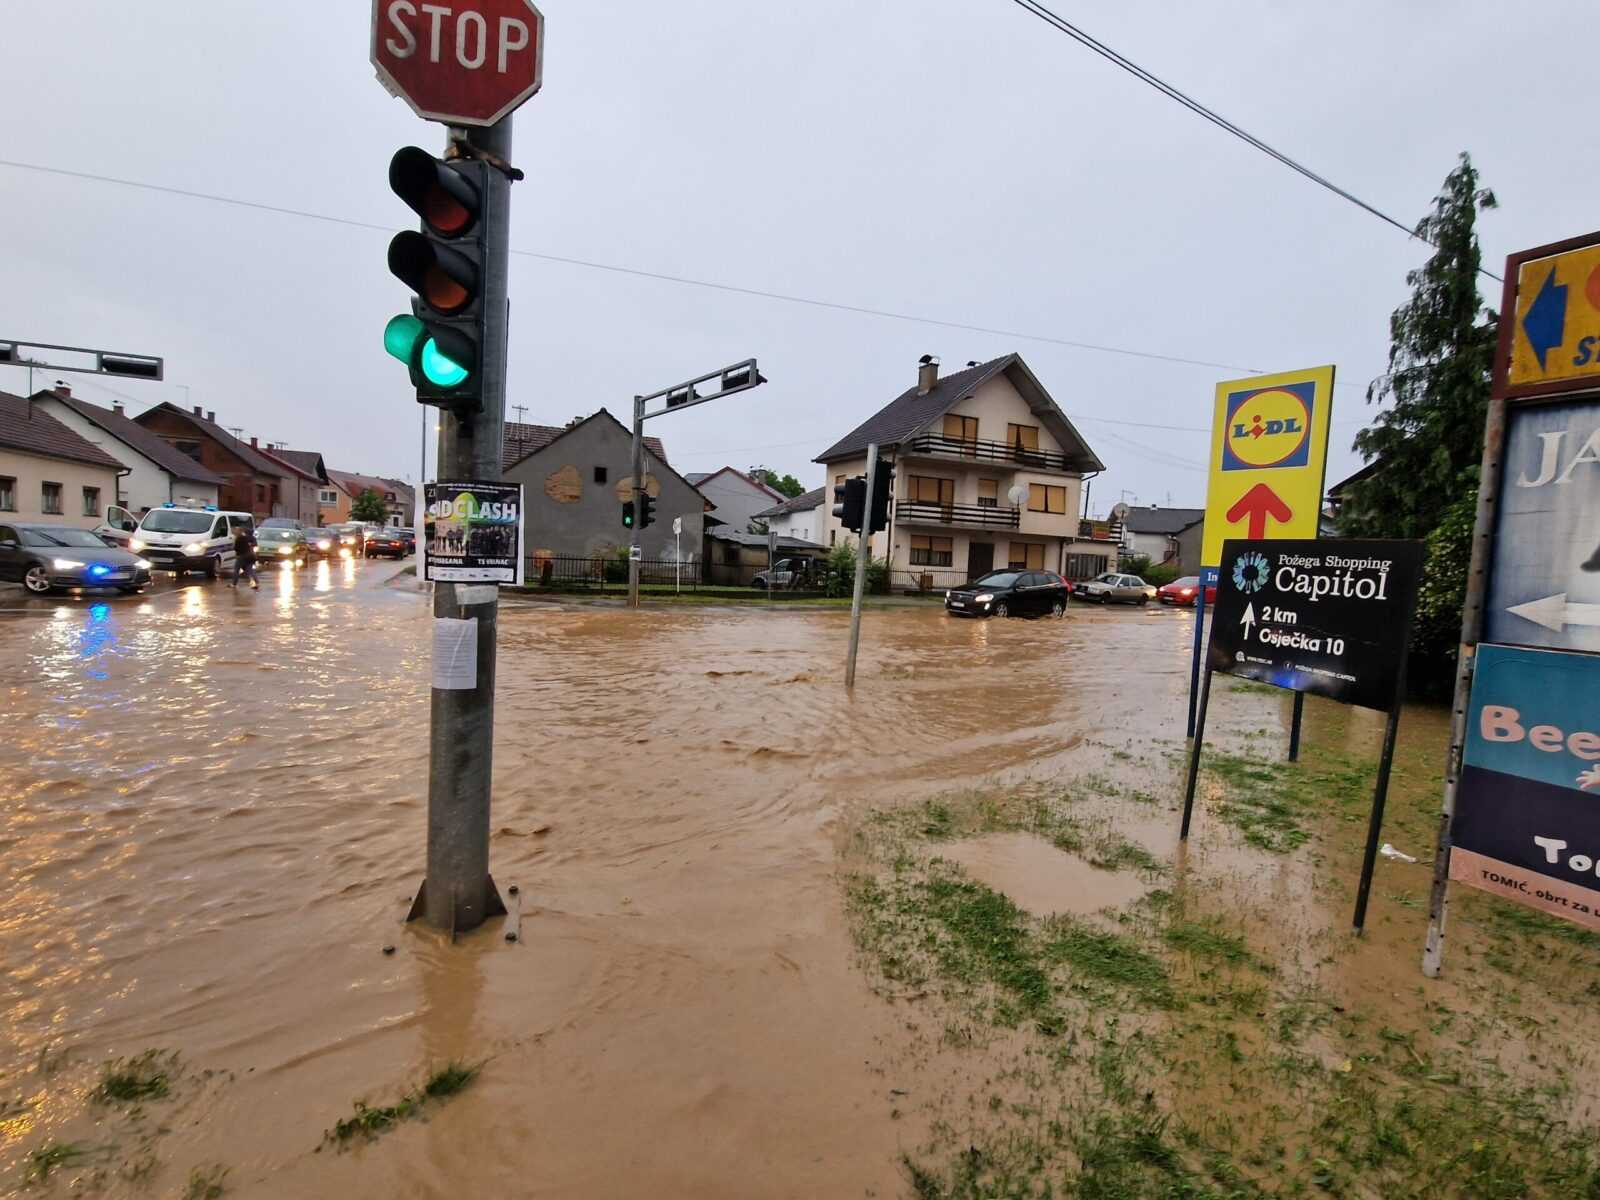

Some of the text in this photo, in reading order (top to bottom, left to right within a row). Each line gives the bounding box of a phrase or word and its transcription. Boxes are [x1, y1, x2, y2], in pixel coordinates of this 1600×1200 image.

[385, 0, 529, 73] STOP
[1572, 335, 1600, 366] S
[1278, 554, 1392, 573] Požega Shopping
[1275, 566, 1387, 602] Capitol
[1262, 606, 1297, 624] 2 km
[1259, 628, 1345, 655] Osječka 10
[1534, 835, 1600, 878] To
[1481, 870, 1531, 896] TOMIĆ,
[1535, 890, 1568, 907] obrt
[1572, 902, 1590, 913] za
